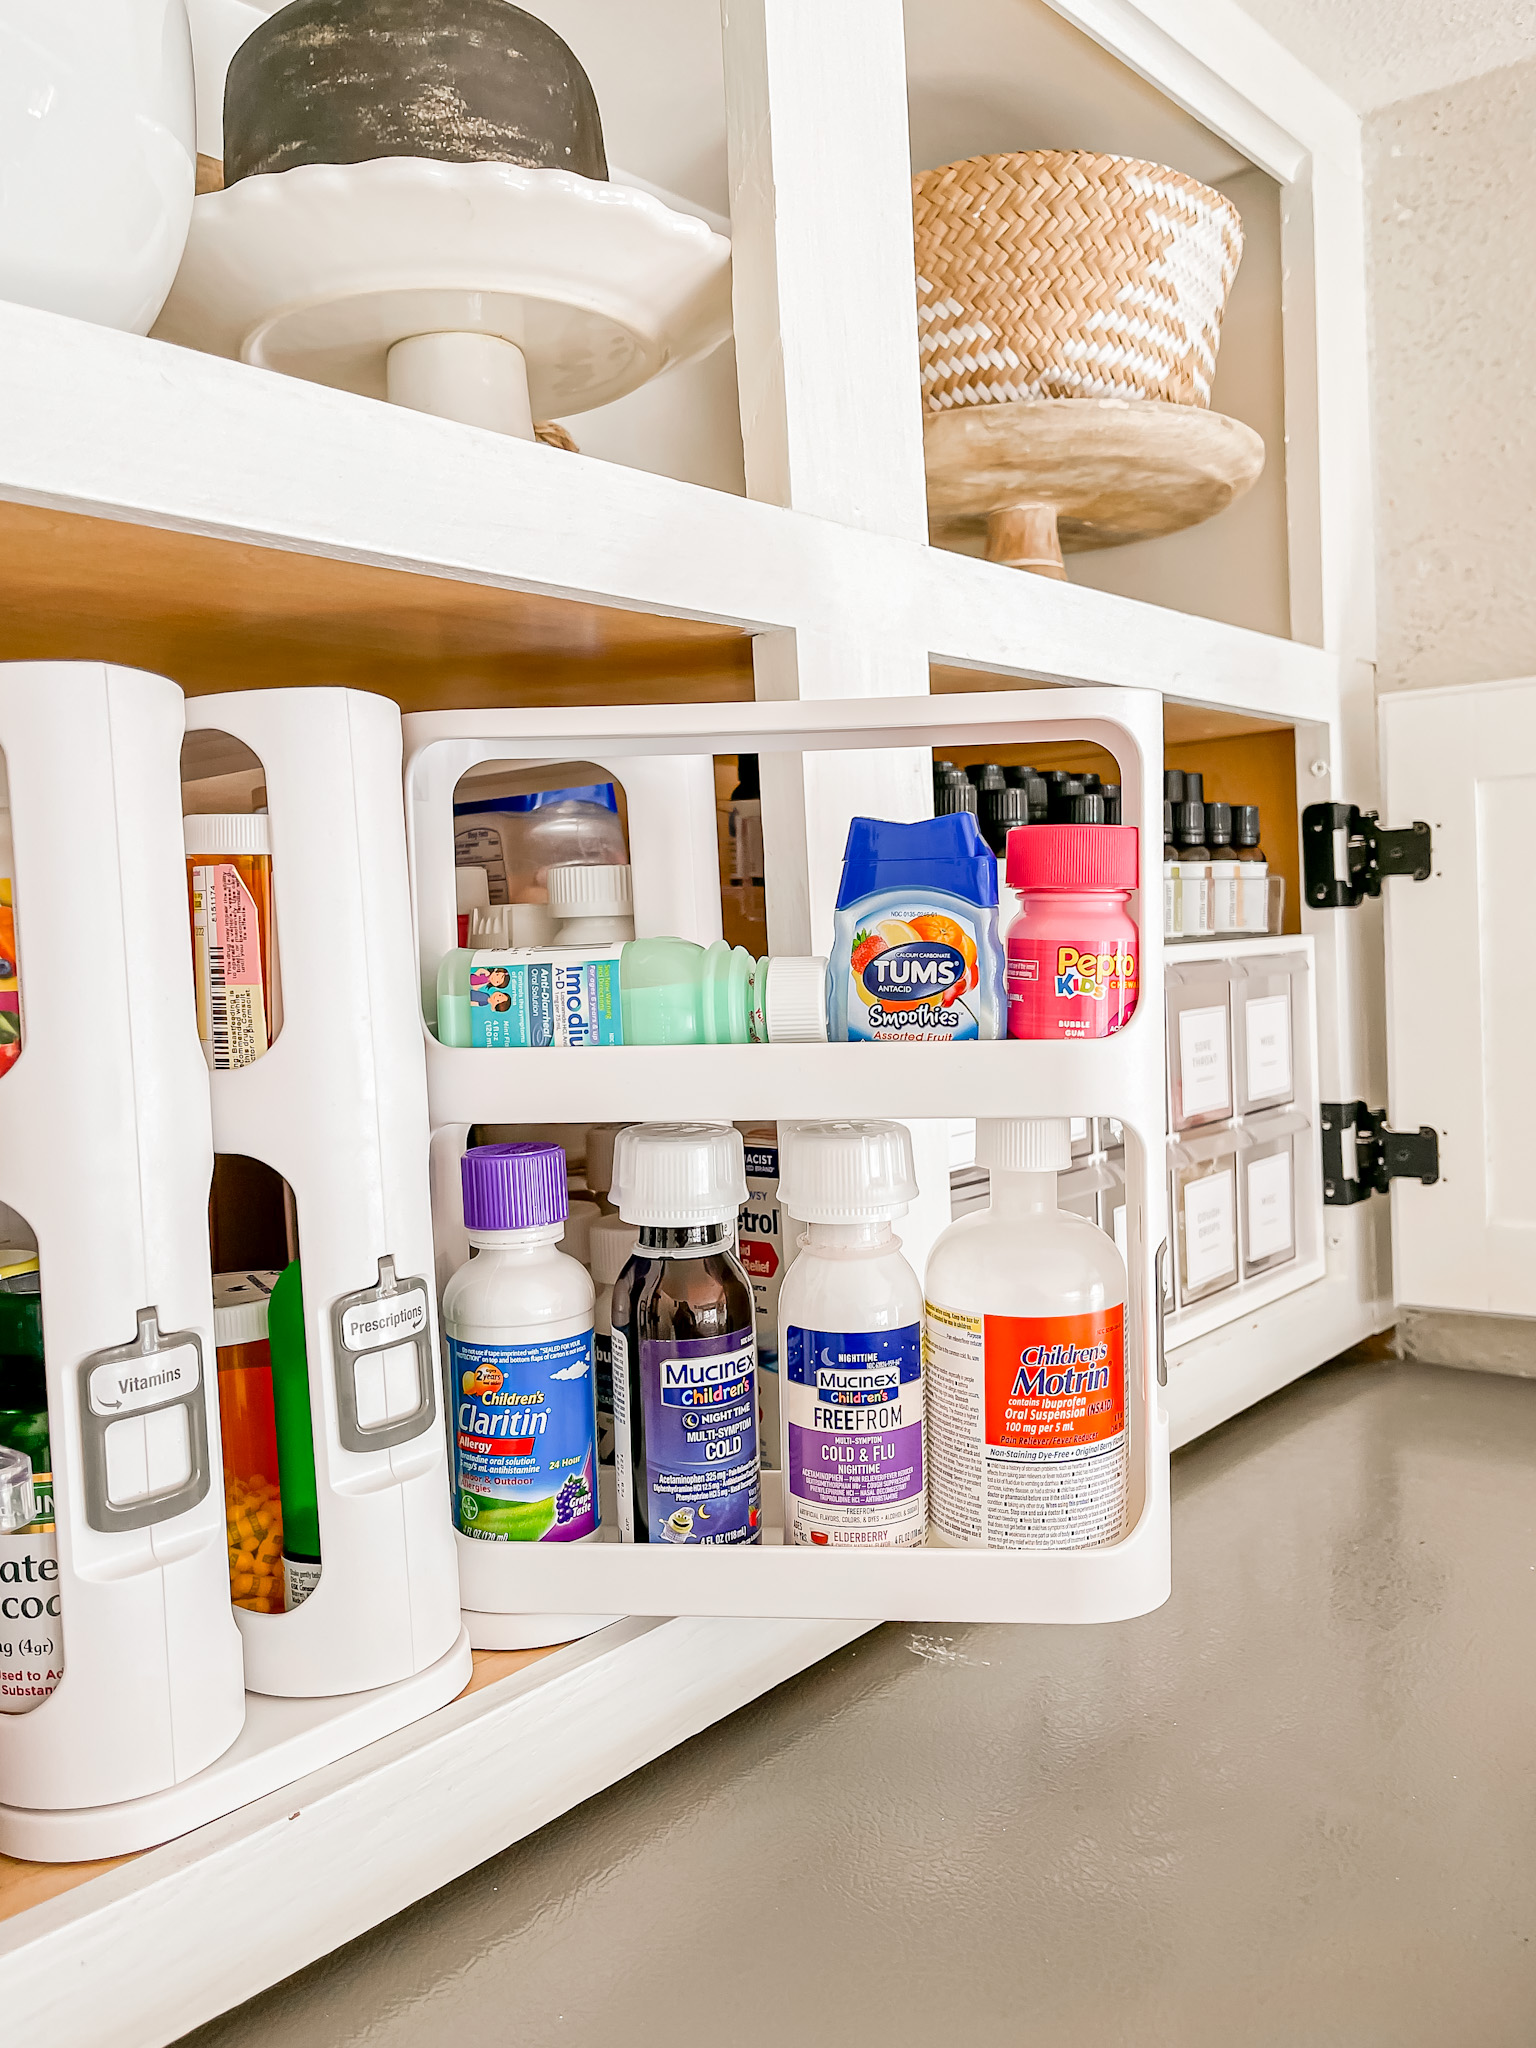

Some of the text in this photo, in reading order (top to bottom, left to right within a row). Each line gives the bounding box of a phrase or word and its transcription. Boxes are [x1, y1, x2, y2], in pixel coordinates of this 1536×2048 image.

[873, 960, 956, 984] TUMS
[1058, 947, 1134, 984] Pepto
[555, 967, 565, 990] A-D
[1057, 973, 1103, 998] KIDS
[531, 968, 539, 1017] Oral Solution
[877, 985, 912, 993] ANTACID
[540, 968, 551, 1038] Anti-Diarrheal
[590, 1002, 598, 1024] years
[869, 1003, 958, 1029] Smoothies
[1058, 1020, 1090, 1028] BUBBLE
[592, 1030, 598, 1041] up
[874, 1031, 953, 1041] Assorted Fruit
[744, 1153, 773, 1165] ACIST
[743, 1260, 770, 1273] Relief
[350, 1304, 422, 1336] Prescriptions
[489, 1357, 498, 1365] top
[510, 1356, 530, 1364] bottom
[550, 1352, 566, 1360] carton
[500, 1349, 527, 1357] imprinted
[838, 1353, 879, 1363] NIGHTTIME
[1021, 1342, 1107, 1366] Children's
[666, 1351, 754, 1385] Mucinex
[118, 1368, 181, 1395] Vitamins
[476, 1370, 501, 1382] 2 years
[820, 1372, 897, 1388] Mucinex
[1012, 1363, 1108, 1396] Motrin
[481, 1390, 545, 1406] Children's
[681, 1376, 750, 1405] Children's
[831, 1389, 888, 1404] Children's
[1008, 1396, 1087, 1410] contains Ibuprofen
[458, 1402, 548, 1436] Claritin
[814, 1405, 902, 1430] FREEFROM
[1004, 1408, 1028, 1420] Oral
[1030, 1408, 1085, 1423] Suspension
[686, 1417, 752, 1443] MULTI-SYMPTOM
[1005, 1421, 1075, 1435] 100 mg per 5 mL
[459, 1435, 492, 1454] Allergy
[835, 1435, 882, 1445] MULTI-SYMPTOM
[1000, 1432, 1098, 1446] Pain Reliever/Fever Reducer
[705, 1435, 742, 1461] COLD
[821, 1443, 895, 1462] COLD & FLU
[990, 1448, 1037, 1461] Non-Staining
[1038, 1449, 1070, 1460] Dye-Free
[1075, 1443, 1100, 1456] Original
[489, 1457, 505, 1466] oral
[505, 1457, 536, 1466] solution
[549, 1455, 581, 1471] 24 Hour
[838, 1463, 880, 1475] NIGHTTIME
[485, 1476, 534, 1486] & Outdoor
[659, 1473, 705, 1485] Acetaminophen
[705, 1472, 717, 1482] 325
[802, 1468, 844, 1482] ACETAMINOPHEN
[569, 1492, 591, 1508] Grape
[572, 1502, 591, 1517] Taste
[846, 1507, 875, 1515] FREEFROM
[868, 1515, 880, 1523] DYES
[715, 1533, 725, 1543] OZ
[833, 1530, 888, 1543] ELDERBERRY
[0, 1555, 58, 1583] ate
[18, 1638, 54, 1656] (4gr)
[26, 1671, 41, 1681] to
